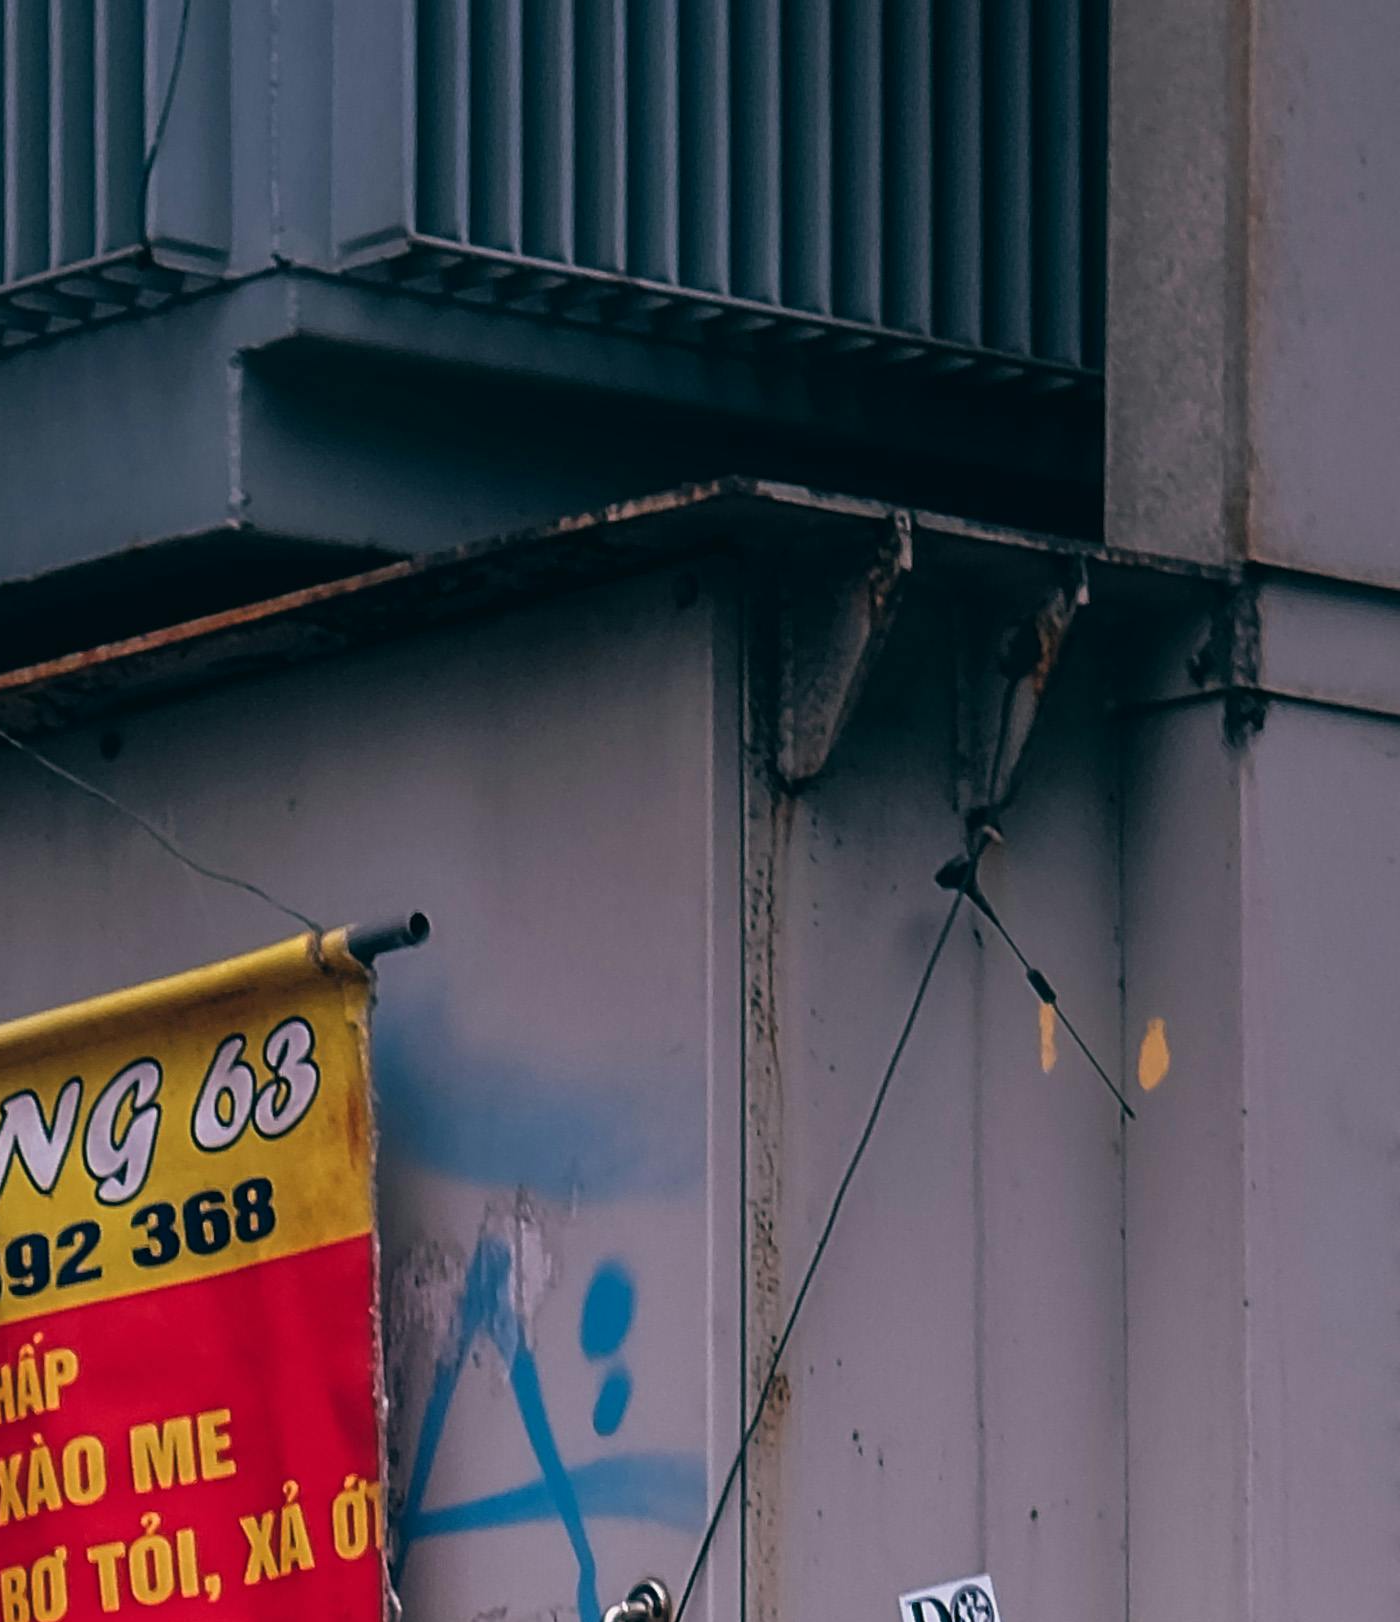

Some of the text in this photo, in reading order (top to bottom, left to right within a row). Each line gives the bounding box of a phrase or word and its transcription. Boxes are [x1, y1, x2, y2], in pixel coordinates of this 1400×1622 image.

[191, 1016, 320, 1152] 63
[131, 1178, 276, 1268] 368
[129, 1408, 237, 1494] ME
[87, 1511, 221, 1613] TỎI,
[239, 1480, 315, 1586] XẢ
